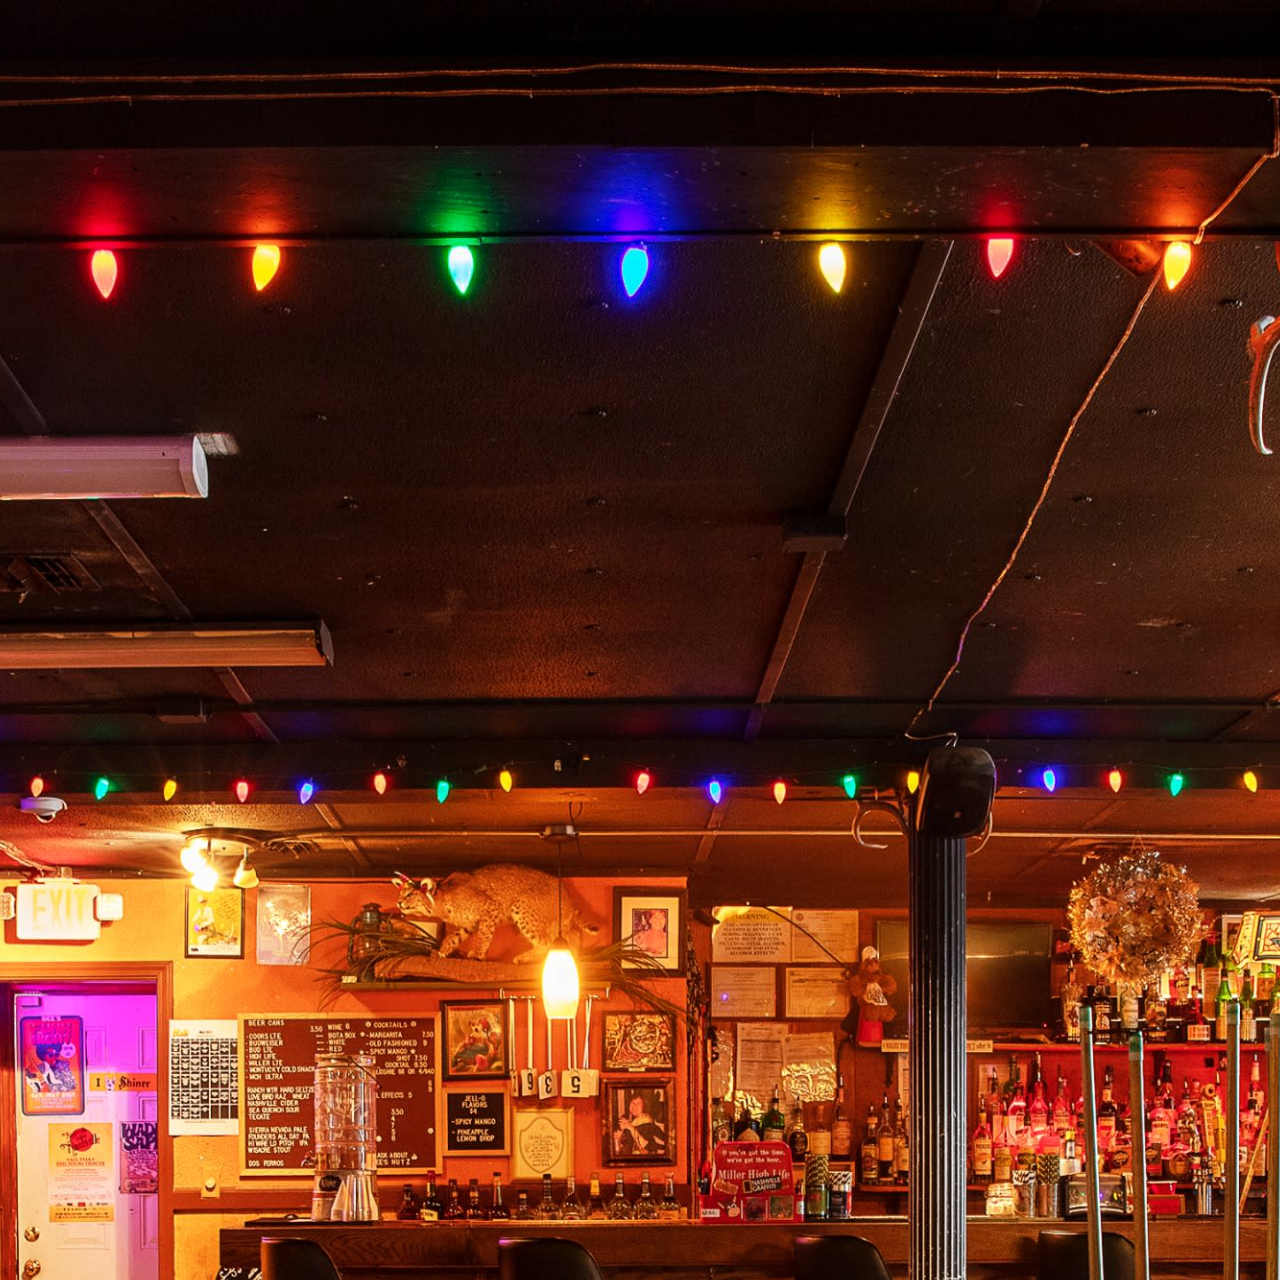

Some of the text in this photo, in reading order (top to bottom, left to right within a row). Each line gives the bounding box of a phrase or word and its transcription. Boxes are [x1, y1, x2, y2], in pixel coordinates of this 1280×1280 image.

[31, 889, 89, 929] EXIT
[96, 1075, 151, 1089] I Shiner
[571, 1076, 581, 1094] 5
[121, 1123, 158, 1138] WAD
[718, 1169, 790, 1180] Miller High Life
